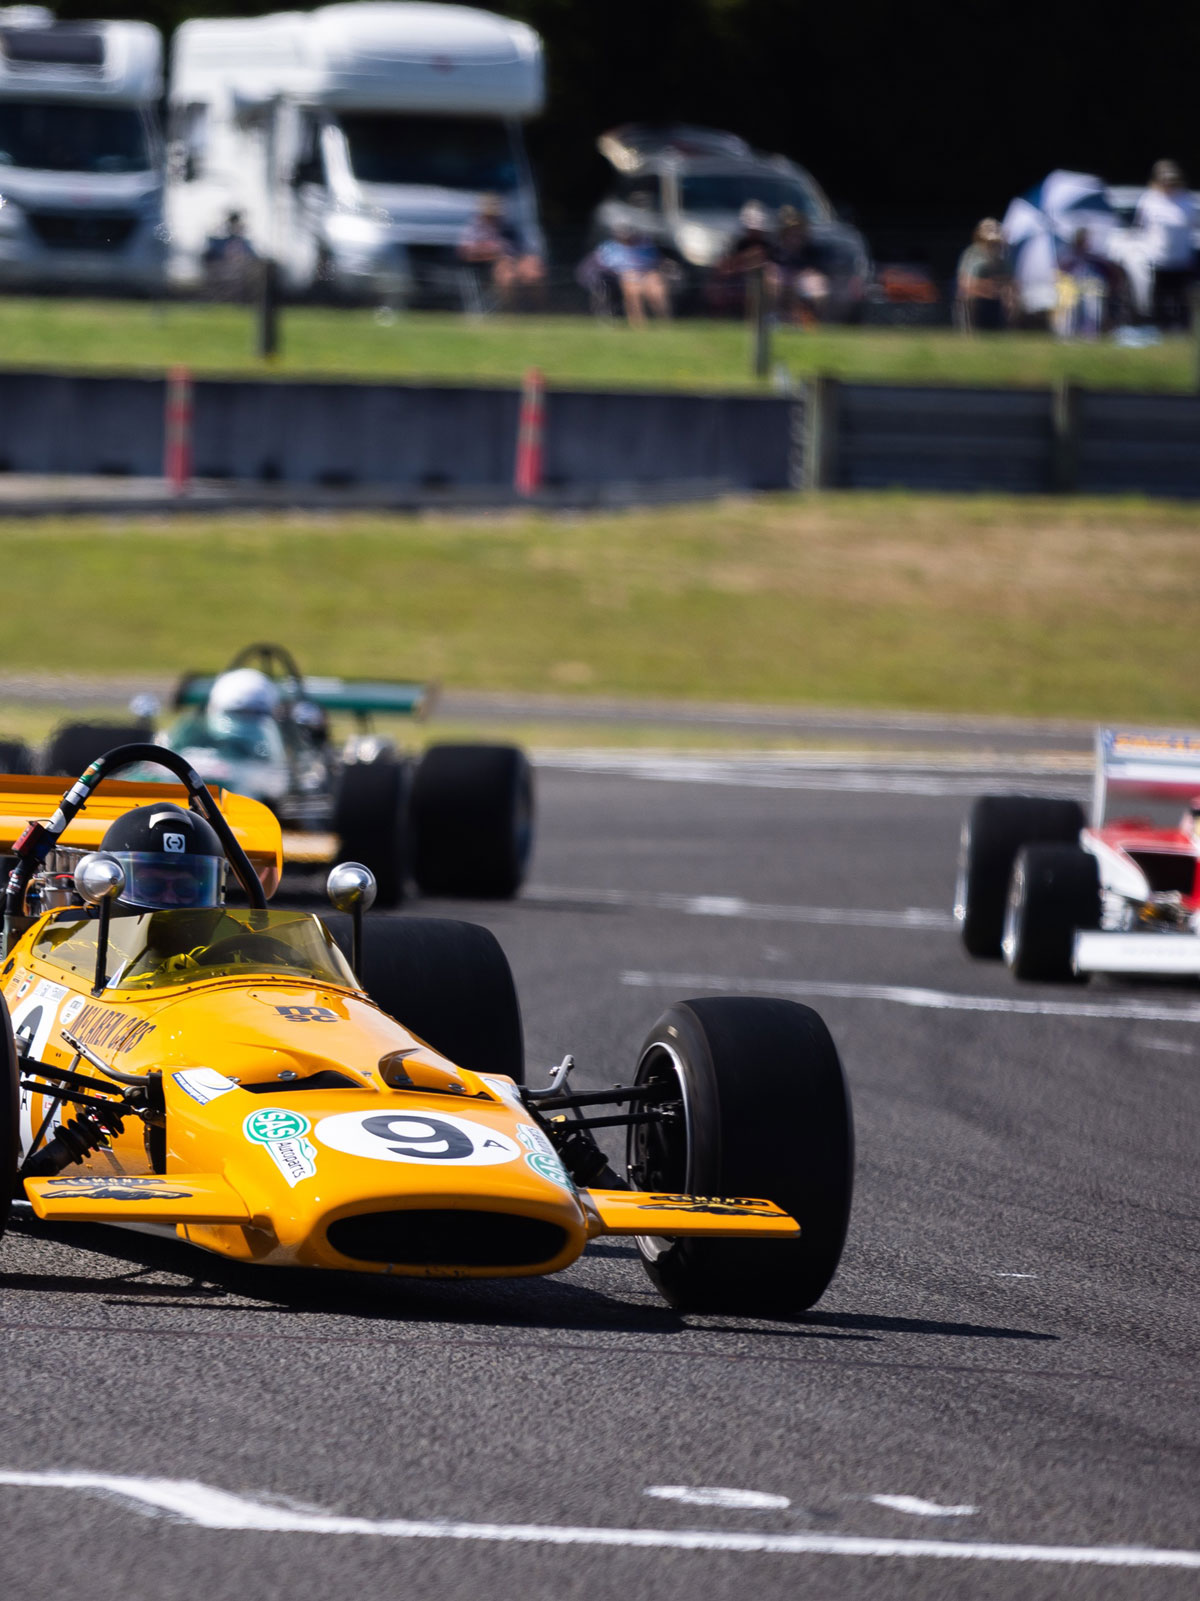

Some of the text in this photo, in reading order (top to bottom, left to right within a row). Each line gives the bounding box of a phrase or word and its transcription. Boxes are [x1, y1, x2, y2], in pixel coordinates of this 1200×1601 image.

[108, 1016, 157, 1054] CARS
[255, 1112, 296, 1138] SAS
[361, 1115, 474, 1160] 9
[276, 1142, 305, 1178] Autoparts
[483, 1139, 511, 1152] A
